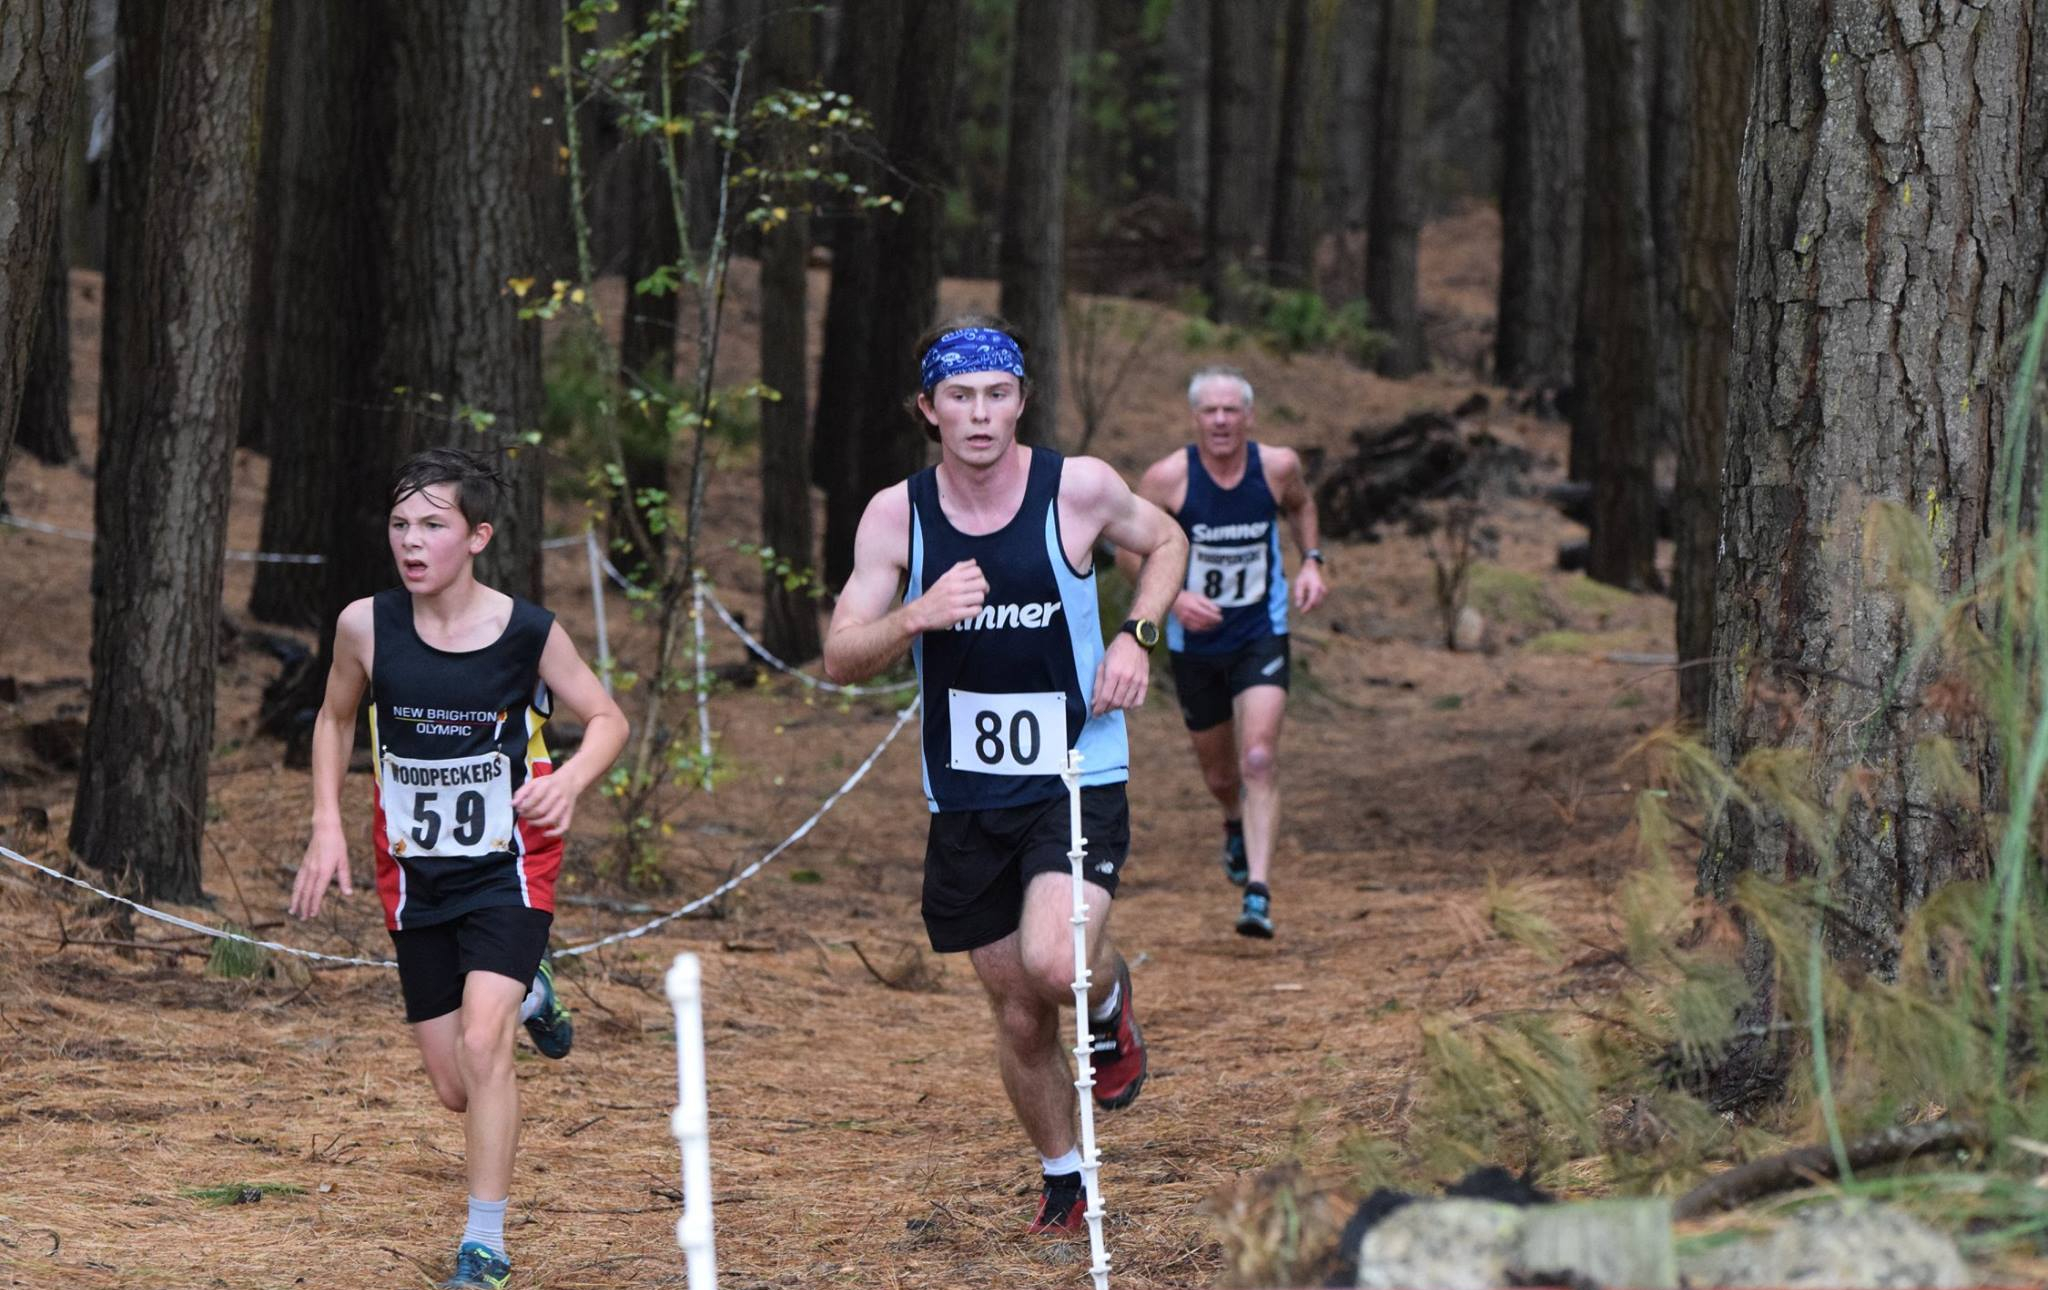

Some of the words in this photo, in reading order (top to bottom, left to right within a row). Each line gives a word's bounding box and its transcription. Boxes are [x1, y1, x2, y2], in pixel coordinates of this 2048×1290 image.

[1204, 568, 1246, 600] 81
[944, 602, 1061, 632] mner
[393, 706, 423, 718] NEW
[427, 709, 497, 722] BRIGHTON
[416, 723, 472, 736] OLYMPIC
[975, 710, 1040, 766] 80
[411, 790, 486, 850] 59
